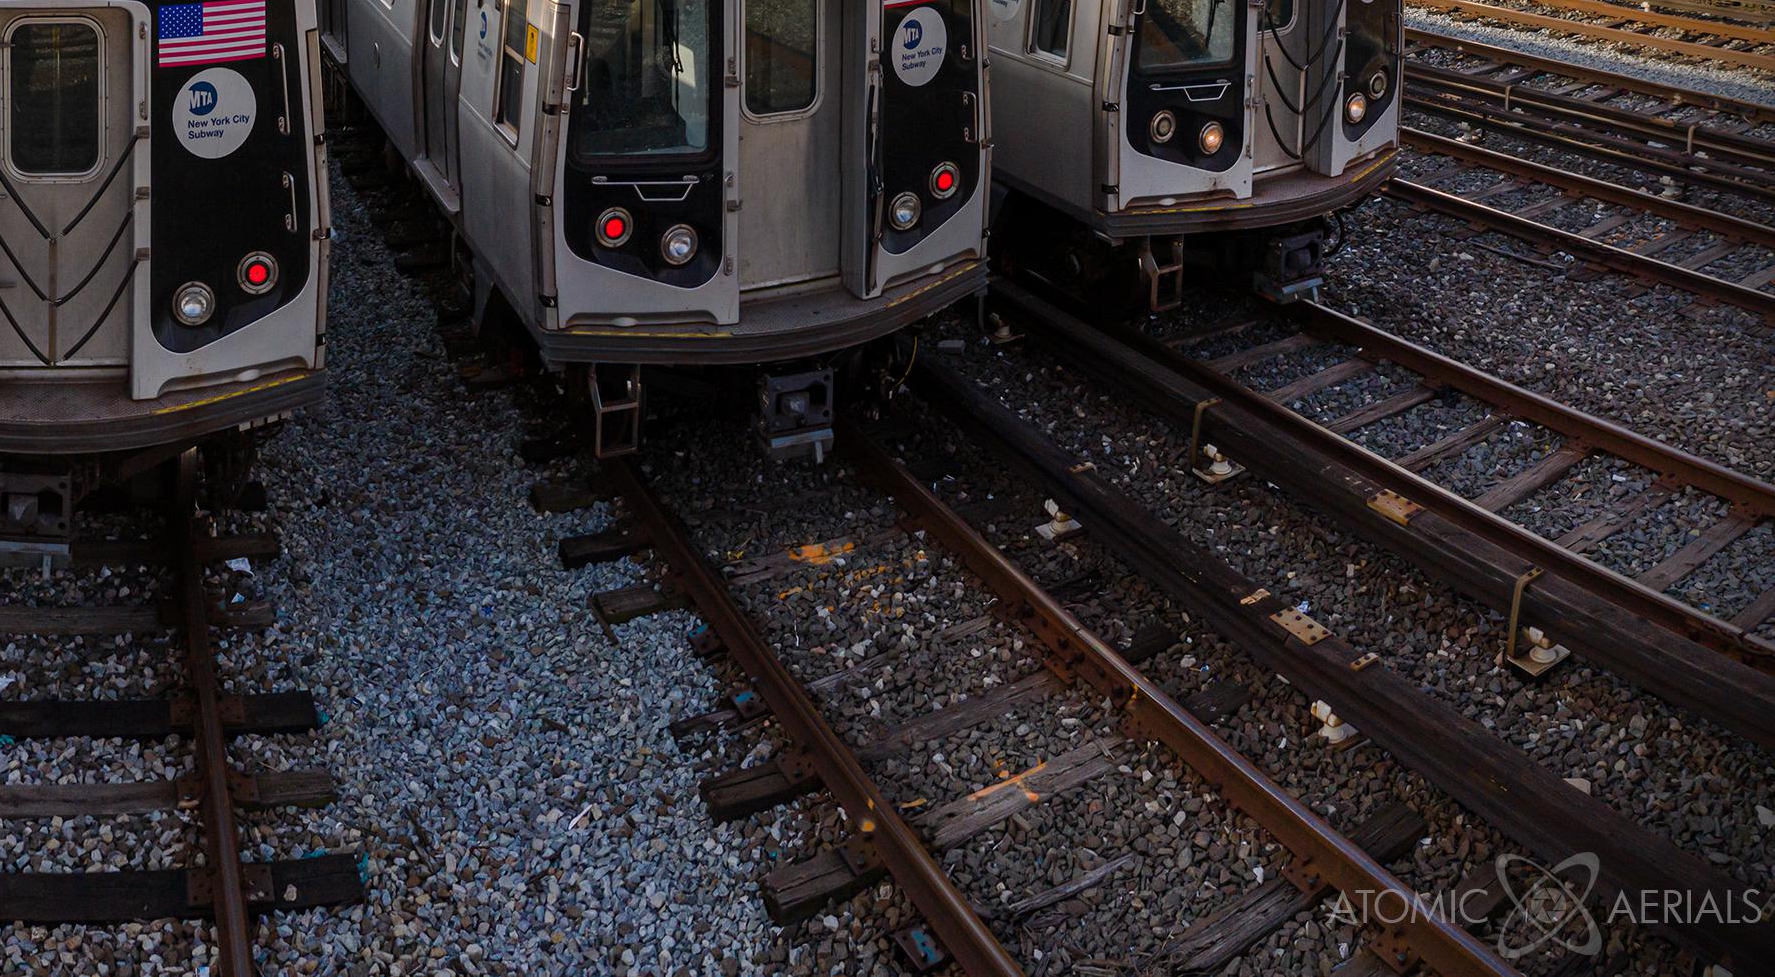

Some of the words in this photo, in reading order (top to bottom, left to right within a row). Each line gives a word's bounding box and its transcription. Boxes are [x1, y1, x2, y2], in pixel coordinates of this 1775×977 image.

[917, 49, 930, 58] York
[931, 47, 942, 55] City
[902, 61, 926, 71] Subway
[188, 90, 213, 109] MTA
[188, 120, 208, 128] New
[211, 117, 230, 126] York
[233, 114, 250, 124] City
[188, 129, 224, 140] Subway
